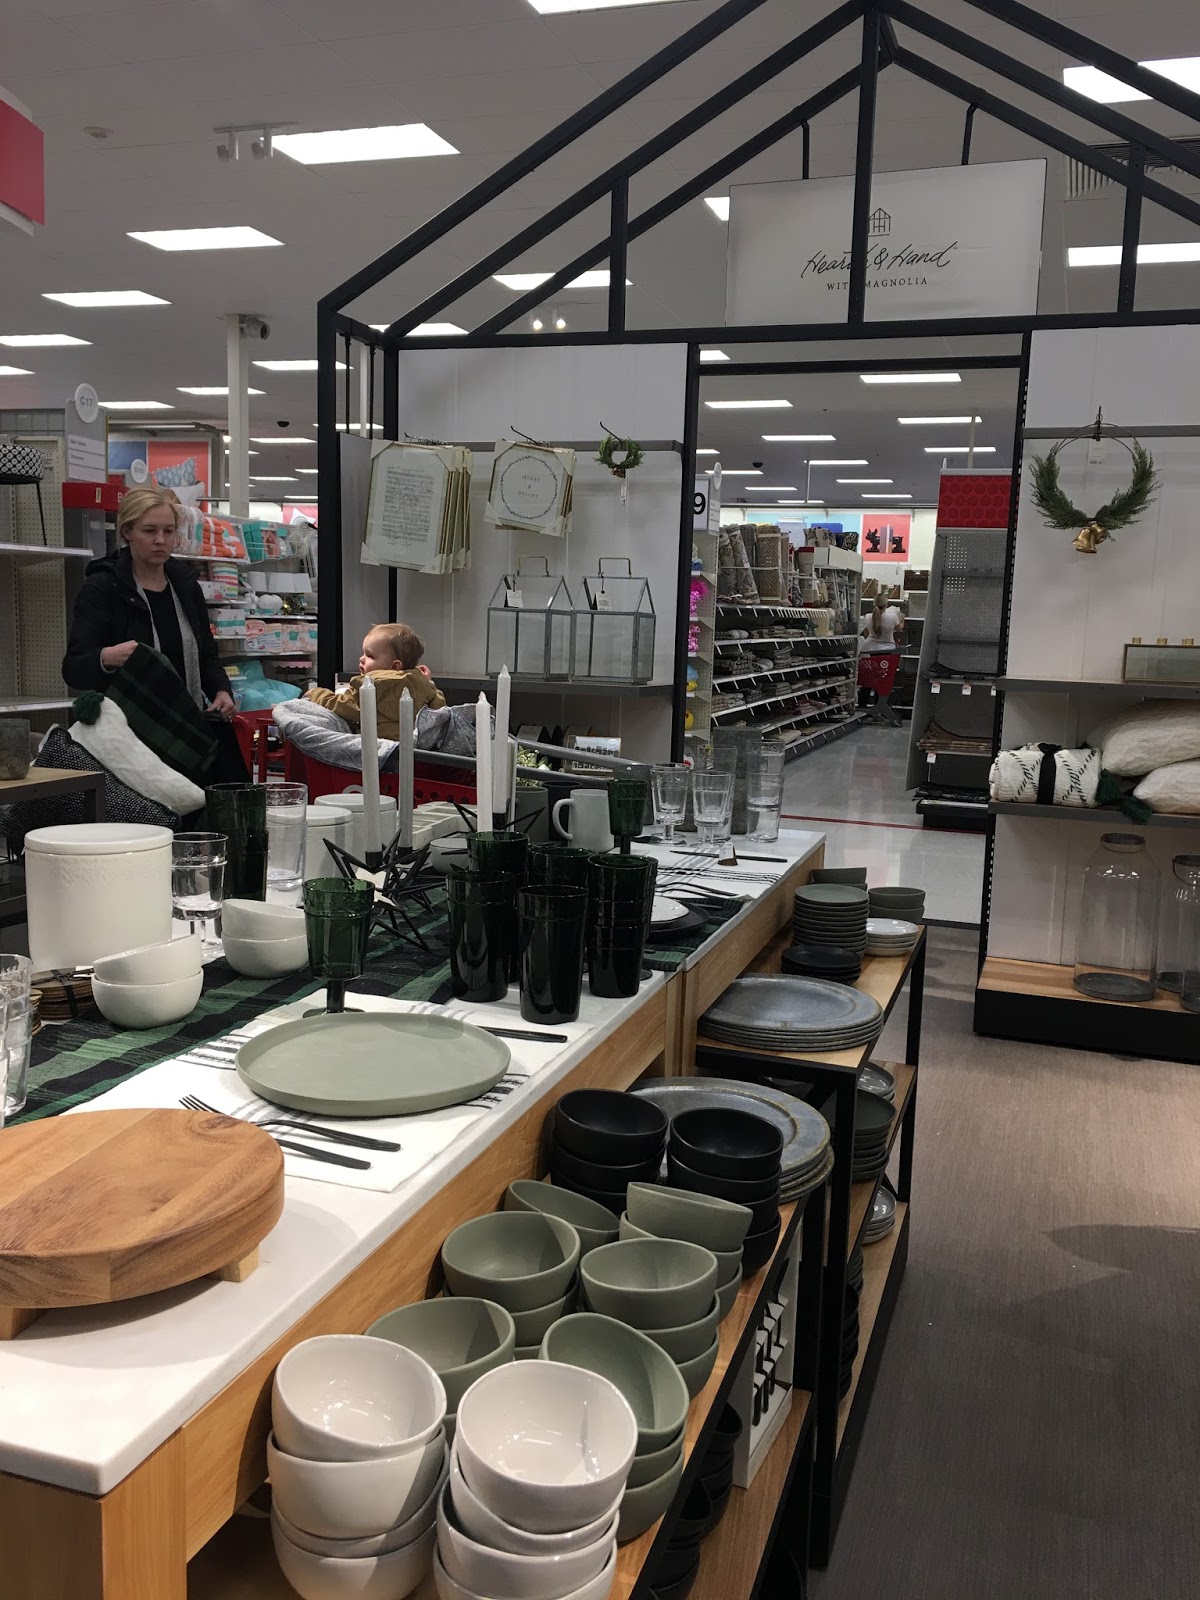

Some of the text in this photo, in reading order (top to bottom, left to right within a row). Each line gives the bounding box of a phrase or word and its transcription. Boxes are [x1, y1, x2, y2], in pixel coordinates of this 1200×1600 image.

[873, 247, 889, 271] &
[886, 241, 958, 270] Hand
[827, 277, 928, 290] WIT MAGNOLIA
[80, 396, 93, 407] C17
